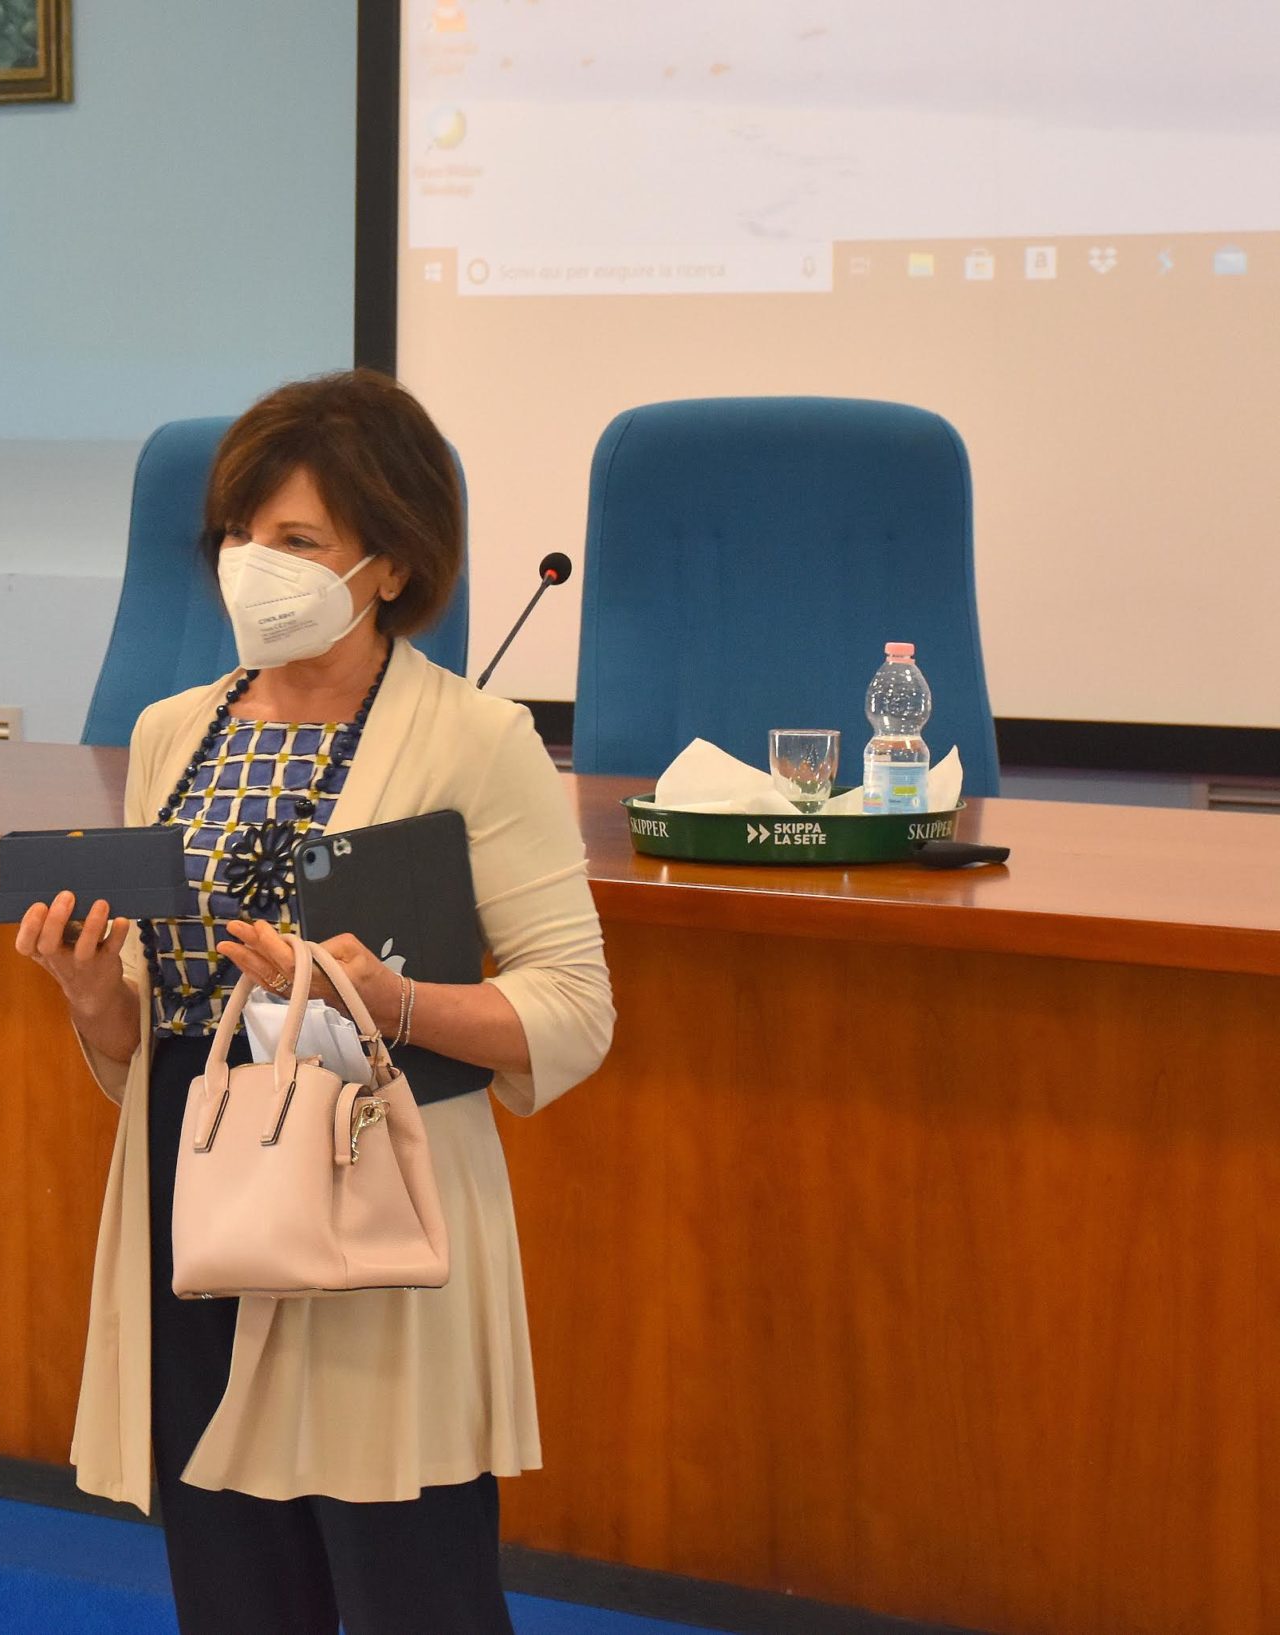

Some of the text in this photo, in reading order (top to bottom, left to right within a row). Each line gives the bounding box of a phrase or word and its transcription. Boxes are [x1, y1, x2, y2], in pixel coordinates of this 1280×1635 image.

[539, 264, 561, 281] qui
[566, 264, 591, 281] per
[676, 262, 726, 278] ricerca
[630, 817, 670, 838] SKIPPER
[774, 823, 822, 834] SKIPPA
[907, 820, 953, 840] SKIPPER
[774, 834, 827, 845] LA SETE
